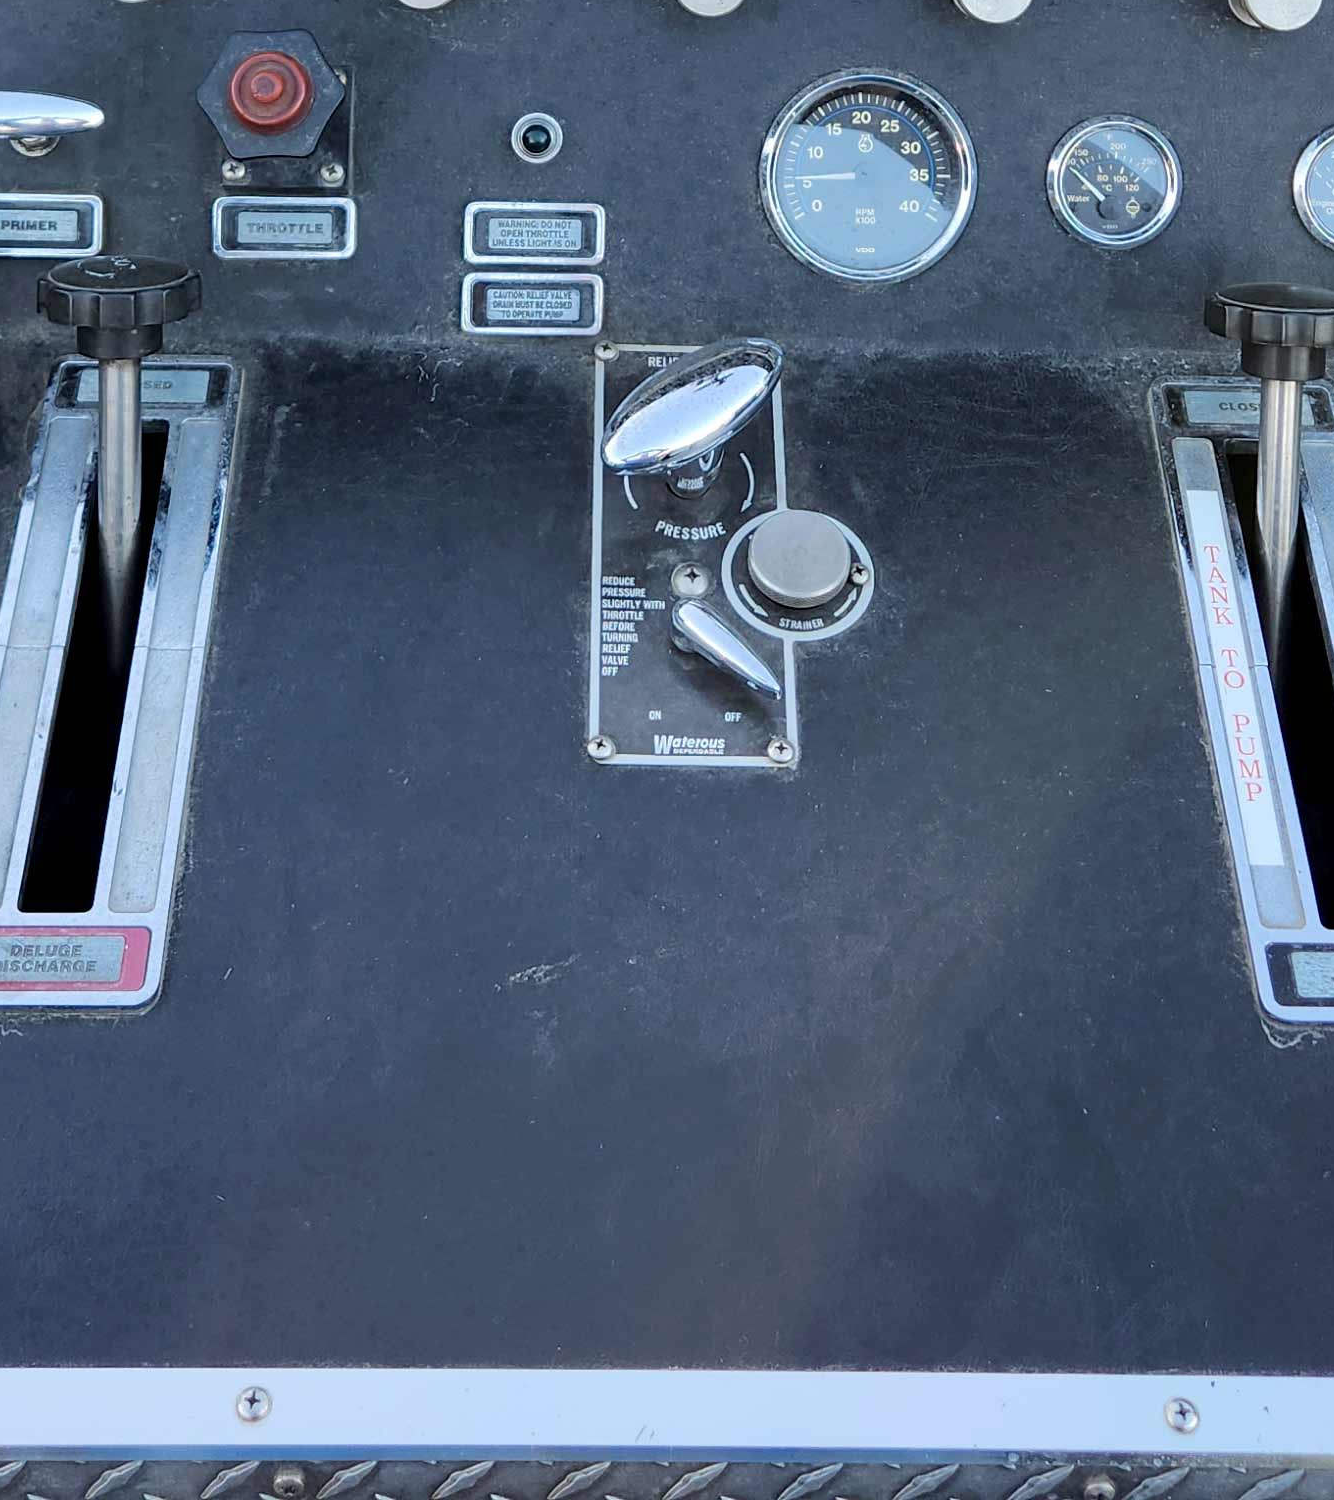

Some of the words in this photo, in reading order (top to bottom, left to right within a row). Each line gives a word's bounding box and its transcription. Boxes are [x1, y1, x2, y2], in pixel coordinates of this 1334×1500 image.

[852, 111, 872, 124] 20
[826, 124, 842, 135] 15
[880, 120, 899, 132] 25
[809, 147, 823, 158] 10
[900, 142, 921, 155] 30
[909, 169, 929, 181] 35
[812, 200, 822, 212] 0
[899, 200, 919, 212] 40
[0, 219, 58, 232] PRIMER
[246, 222, 324, 235] THROTTLE
[541, 220, 552, 228] DO
[555, 221, 571, 229] NOT
[501, 230, 524, 238] OPEN
[526, 230, 569, 238] THROTTLE
[492, 239, 525, 247] UNLESS
[528, 239, 552, 247] LIGHT
[565, 240, 576, 248] ON
[655, 520, 726, 540] PRESSURE
[602, 576, 635, 586] REDUCE
[602, 588, 646, 597] PRESSURE
[602, 599, 642, 609] SLIGHTLY
[644, 600, 666, 609] WITH
[602, 611, 644, 620] THROTTLE
[602, 622, 635, 631] BEFORE
[779, 617, 824, 630] STRAINER
[602, 633, 638, 642] TURNING
[602, 644, 631, 653] RELIEF
[602, 656, 629, 665] VALVE
[602, 667, 618, 676] OFF
[1203, 545, 1234, 626] TANK
[1221, 648, 1245, 690] TO
[1233, 714, 1262, 802] PUMP
[649, 710, 662, 720] ON
[725, 712, 741, 722] OFF
[654, 735, 725, 754] Waterous
[10, 945, 83, 957] DELUGE
